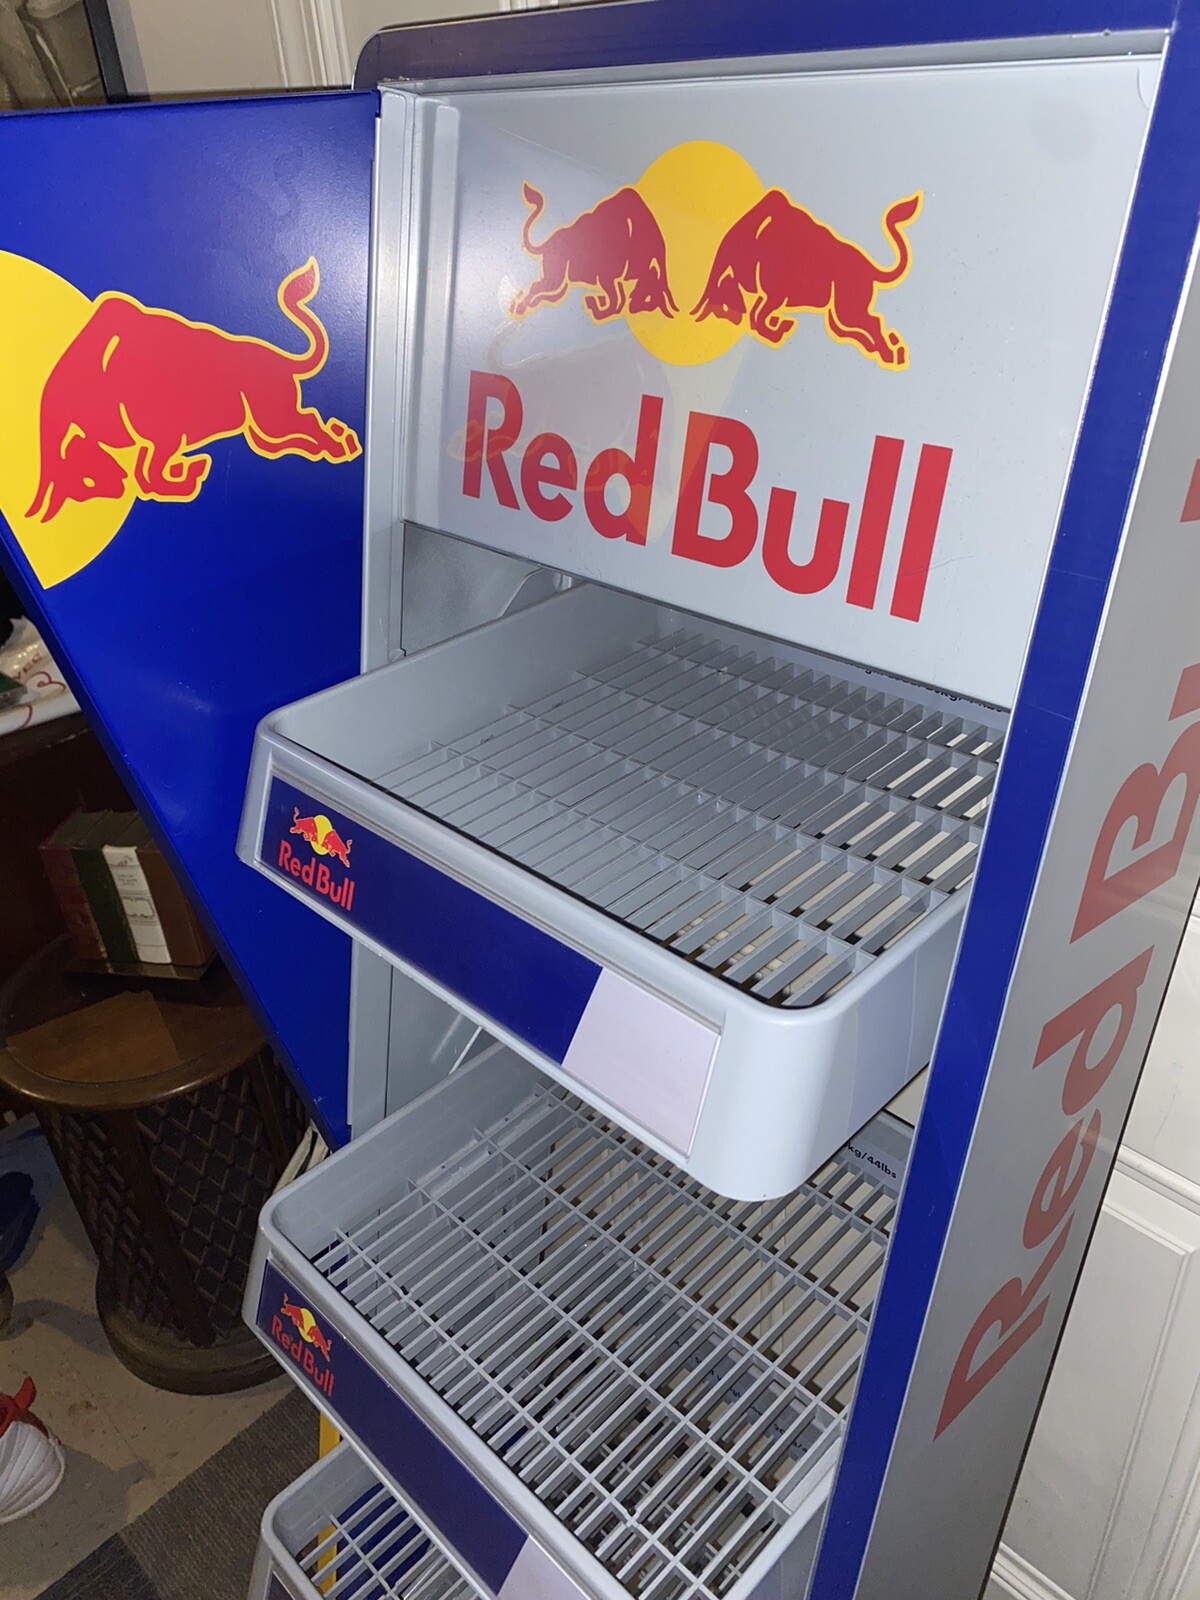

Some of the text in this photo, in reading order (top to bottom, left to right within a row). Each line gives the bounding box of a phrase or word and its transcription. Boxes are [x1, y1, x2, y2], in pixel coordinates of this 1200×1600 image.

[461, 369, 954, 623] Red Bull
[279, 840, 355, 911] Red Bull
[933, 944, 1155, 1442] Red
[272, 1315, 334, 1396] Red Bull
